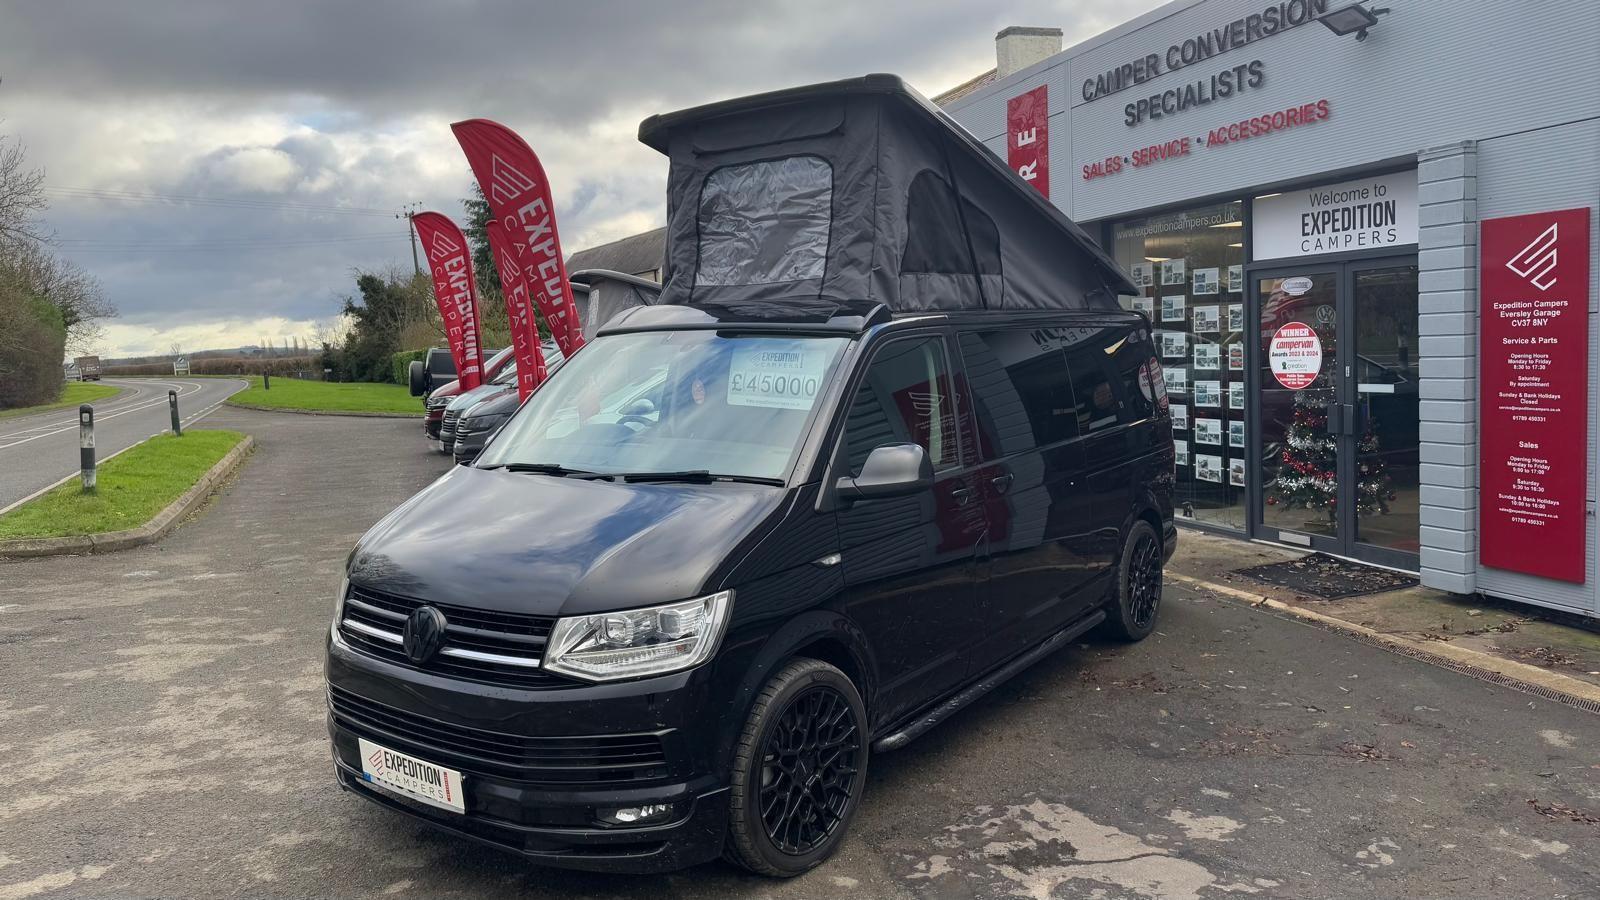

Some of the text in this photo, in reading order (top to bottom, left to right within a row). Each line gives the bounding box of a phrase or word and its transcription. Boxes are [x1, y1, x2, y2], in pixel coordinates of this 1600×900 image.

[1082, 0, 1328, 101] CAMPER CONVERSION
[1124, 60, 1265, 126] SPECIALISTS
[1082, 98, 1330, 180] SALES SERVICE ACCESSORIES
[1309, 183, 1387, 208] Welcome to
[1116, 209, 1236, 240] www.expeditioncampers.co.uk
[1301, 199, 1396, 237] EXPEDITION
[1301, 228, 1397, 252] CAMPERS
[1494, 300, 1568, 310] Expedition Campers
[1280, 328, 1309, 337] WINNER
[1512, 319, 1530, 327] CV37
[761, 351, 800, 363] EXPEDITION
[1276, 340, 1314, 350] campervan
[731, 373, 817, 397] £45000
[1519, 441, 1538, 449] Sales
[1517, 478, 1539, 486] Saturday
[384, 751, 442, 788] EXPEDITION
[386, 771, 444, 800] CAMPERS
